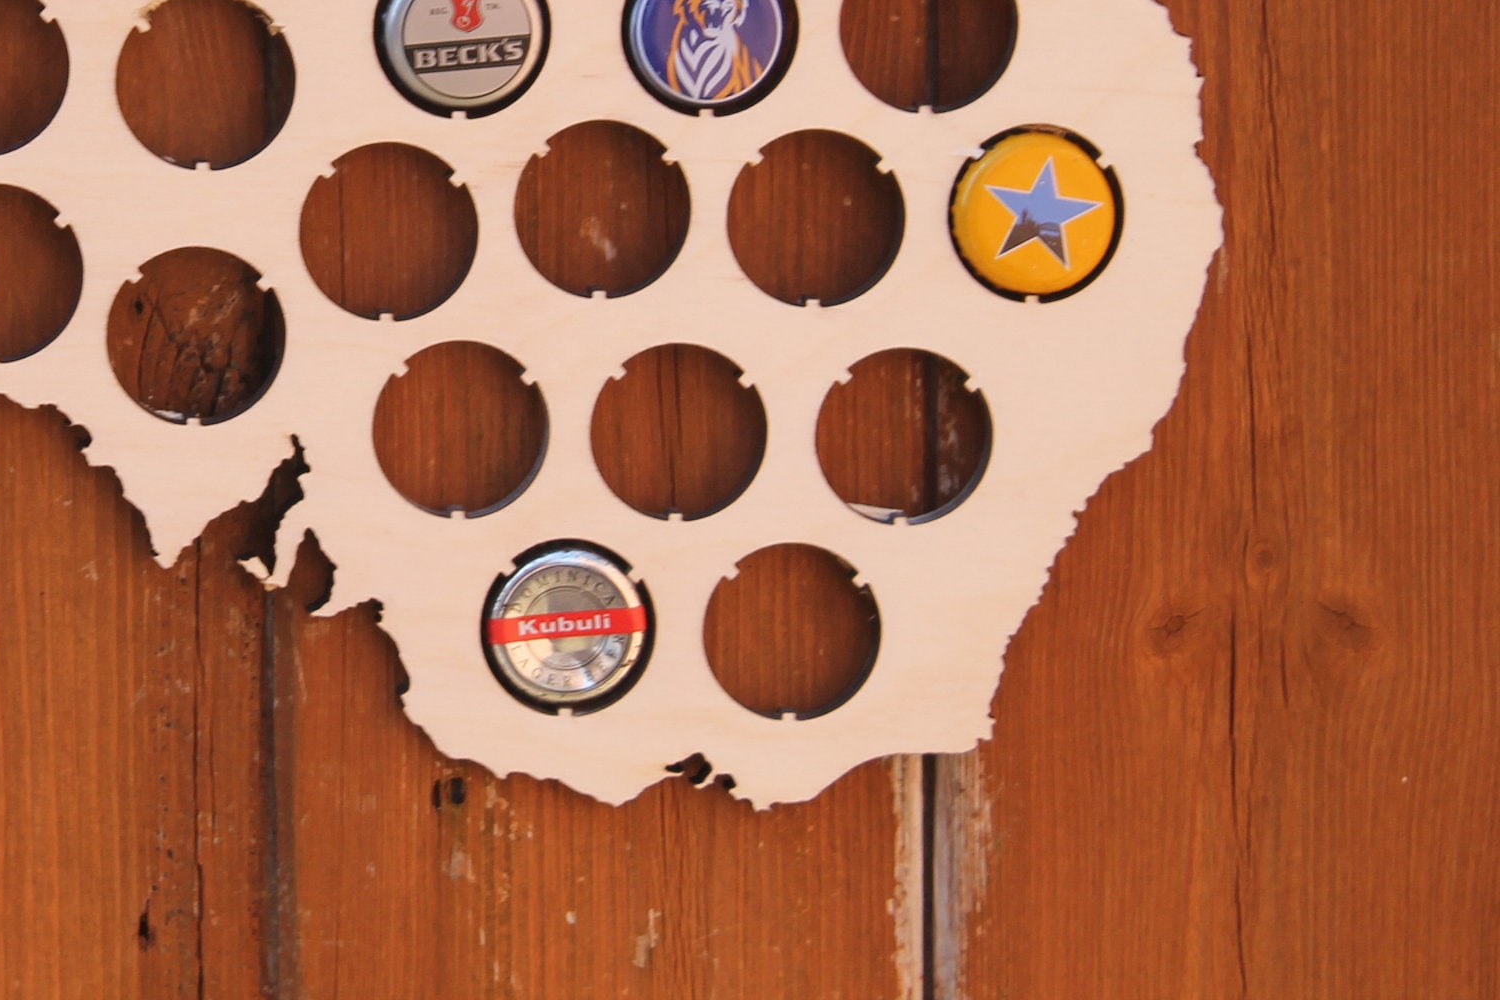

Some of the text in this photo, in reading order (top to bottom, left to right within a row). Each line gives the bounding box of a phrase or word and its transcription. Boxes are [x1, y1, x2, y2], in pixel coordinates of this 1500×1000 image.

[413, 38, 525, 70] BECK'S
[507, 569, 617, 614] DOMINICA
[518, 613, 612, 637] Kubuli
